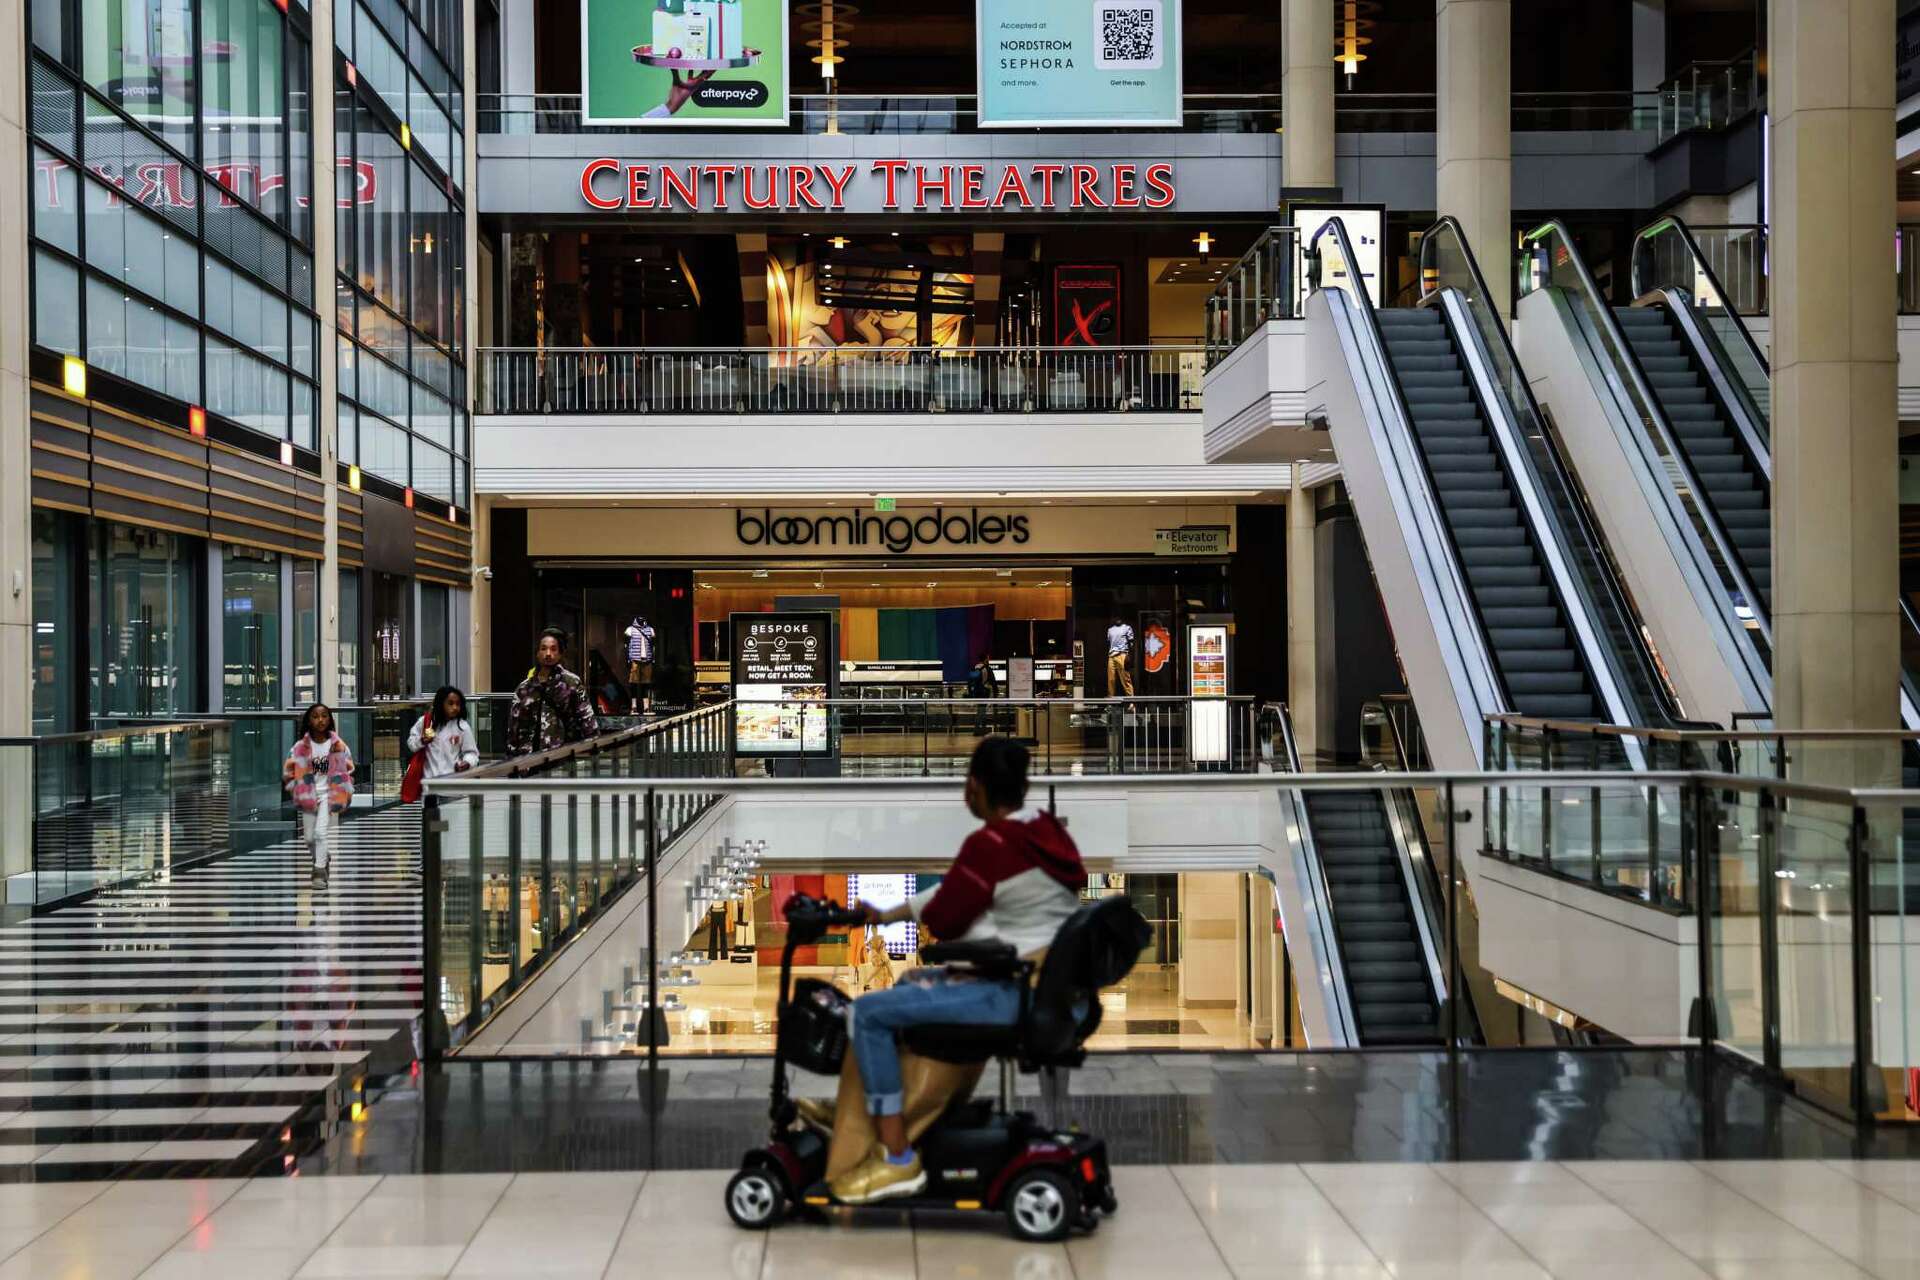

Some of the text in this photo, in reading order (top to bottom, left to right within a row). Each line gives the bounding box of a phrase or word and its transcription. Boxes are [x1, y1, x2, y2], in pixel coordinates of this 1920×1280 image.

[1001, 22, 1037, 30] Accepted
[1001, 41, 1072, 51] NORDSTROM
[1001, 59, 1074, 70] SEPHORA
[701, 88, 746, 101] afterpay
[581, 158, 1175, 210] CENTURY THEATRES
[736, 508, 1030, 553] bloomingdale's
[1171, 531, 1217, 542] Elevator
[1171, 543, 1218, 553] Restrooms
[751, 624, 808, 635] BESPOKE
